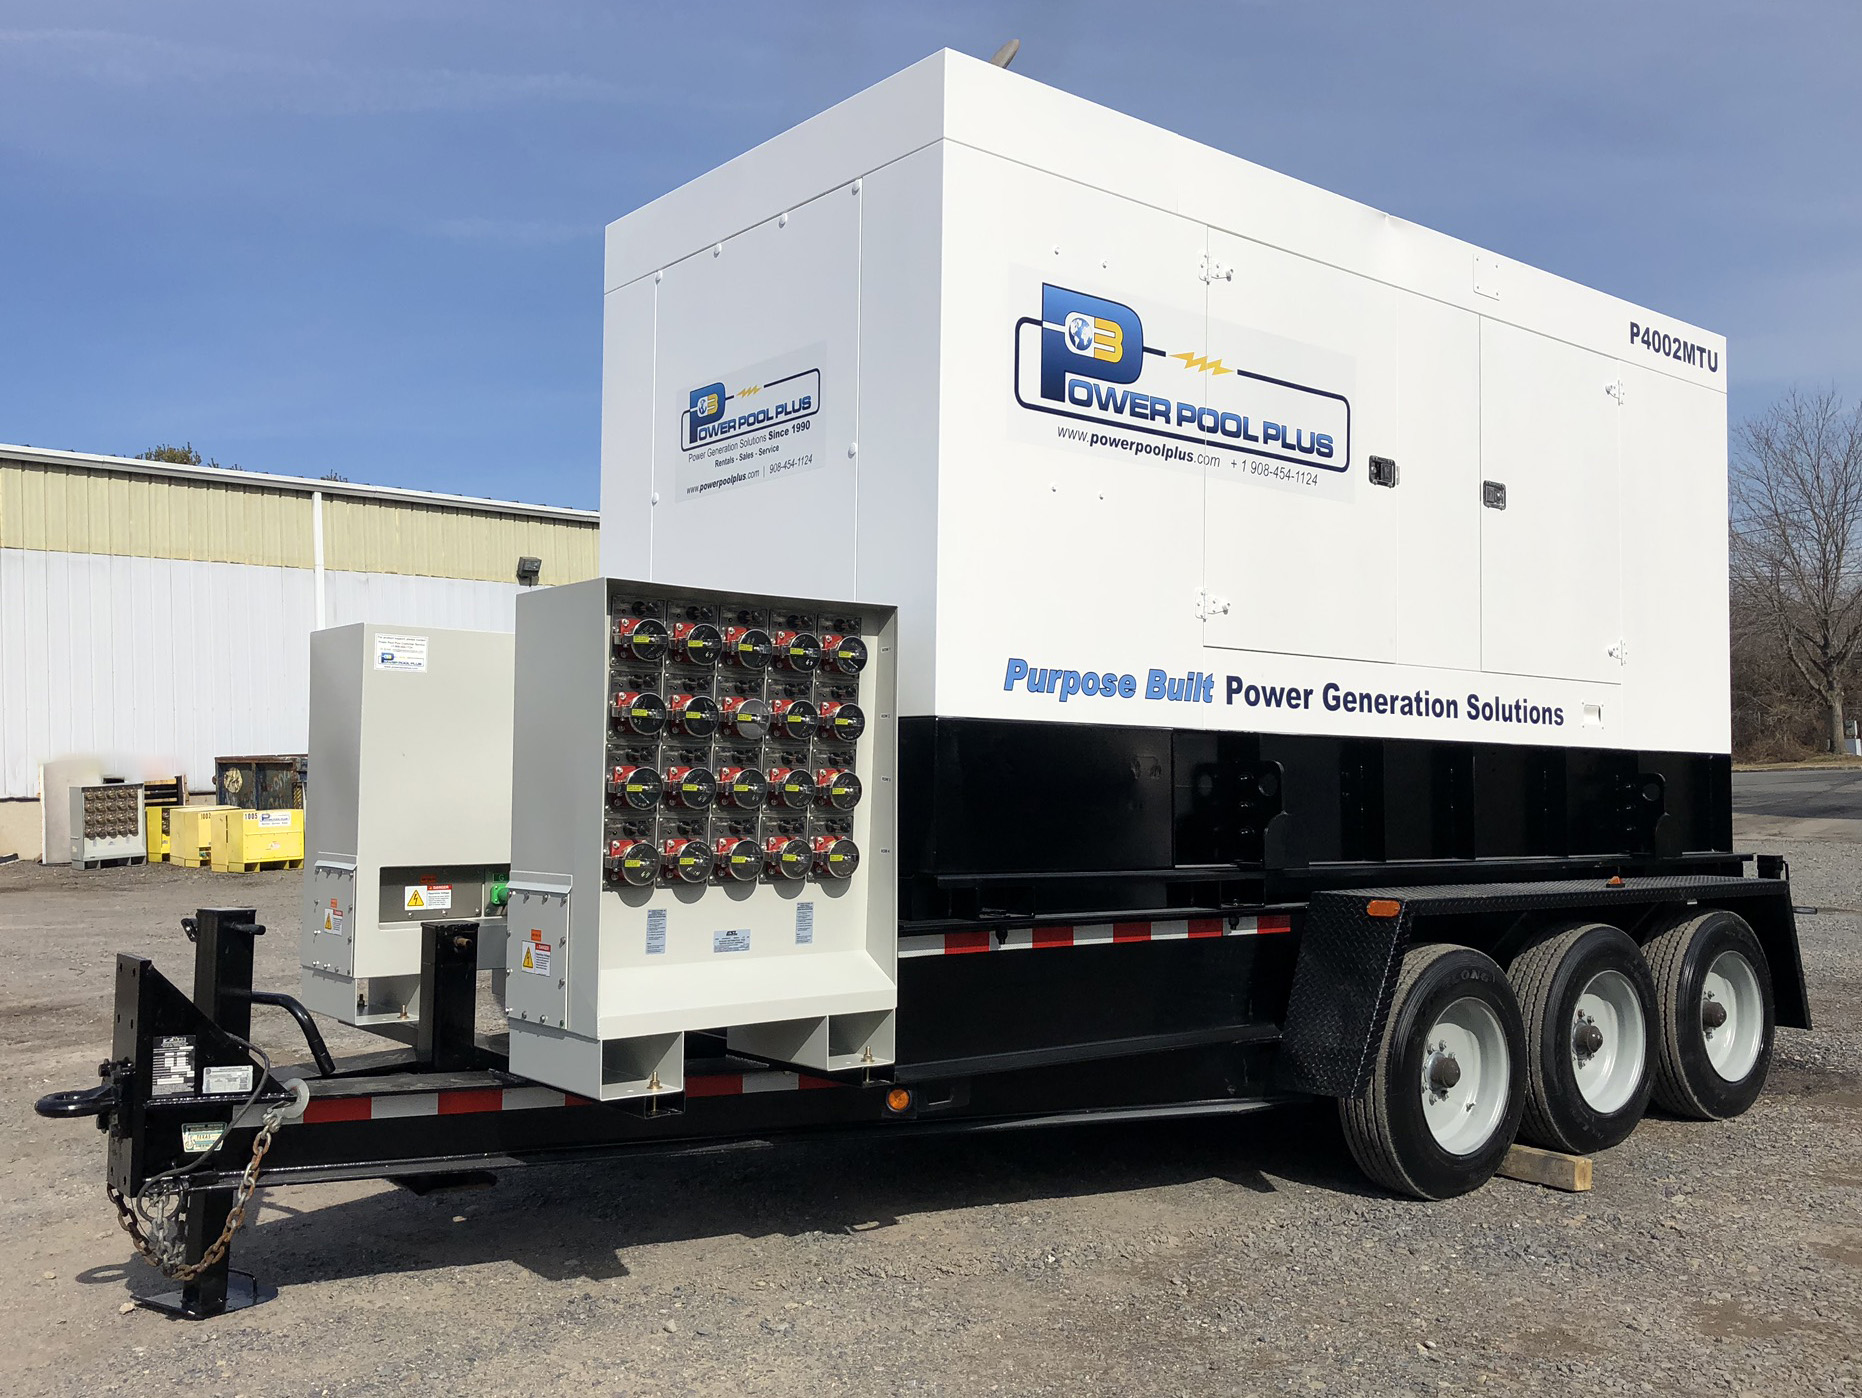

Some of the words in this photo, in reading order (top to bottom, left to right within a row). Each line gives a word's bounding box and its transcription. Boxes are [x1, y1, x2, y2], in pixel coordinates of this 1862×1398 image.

[1629, 321, 1718, 373] P4002MTU
[738, 408, 774, 430] POOL
[775, 395, 812, 419] PLUS
[1177, 401, 1259, 444] POOL
[1263, 421, 1334, 459] PLUS
[688, 452, 706, 463] Power
[707, 442, 738, 458] Generation
[739, 433, 767, 449] Solutions
[768, 427, 790, 441] Since
[792, 420, 811, 434] 1990
[714, 456, 735, 468] Rentals
[739, 450, 754, 462] Sales
[758, 444, 780, 457] Service
[1057, 425, 1221, 468] www.powerpoolplus.com
[1250, 462, 1319, 487] 908-454-1124
[686, 469, 760, 494] www.powerpoolplus.com
[769, 454, 813, 474] 908-454-1124
[1003, 657, 1137, 702] Purpose
[1145, 668, 1215, 703] Built
[1226, 675, 1314, 710] Power
[1322, 682, 1459, 719] Generation
[1466, 693, 1565, 726] Solutions
